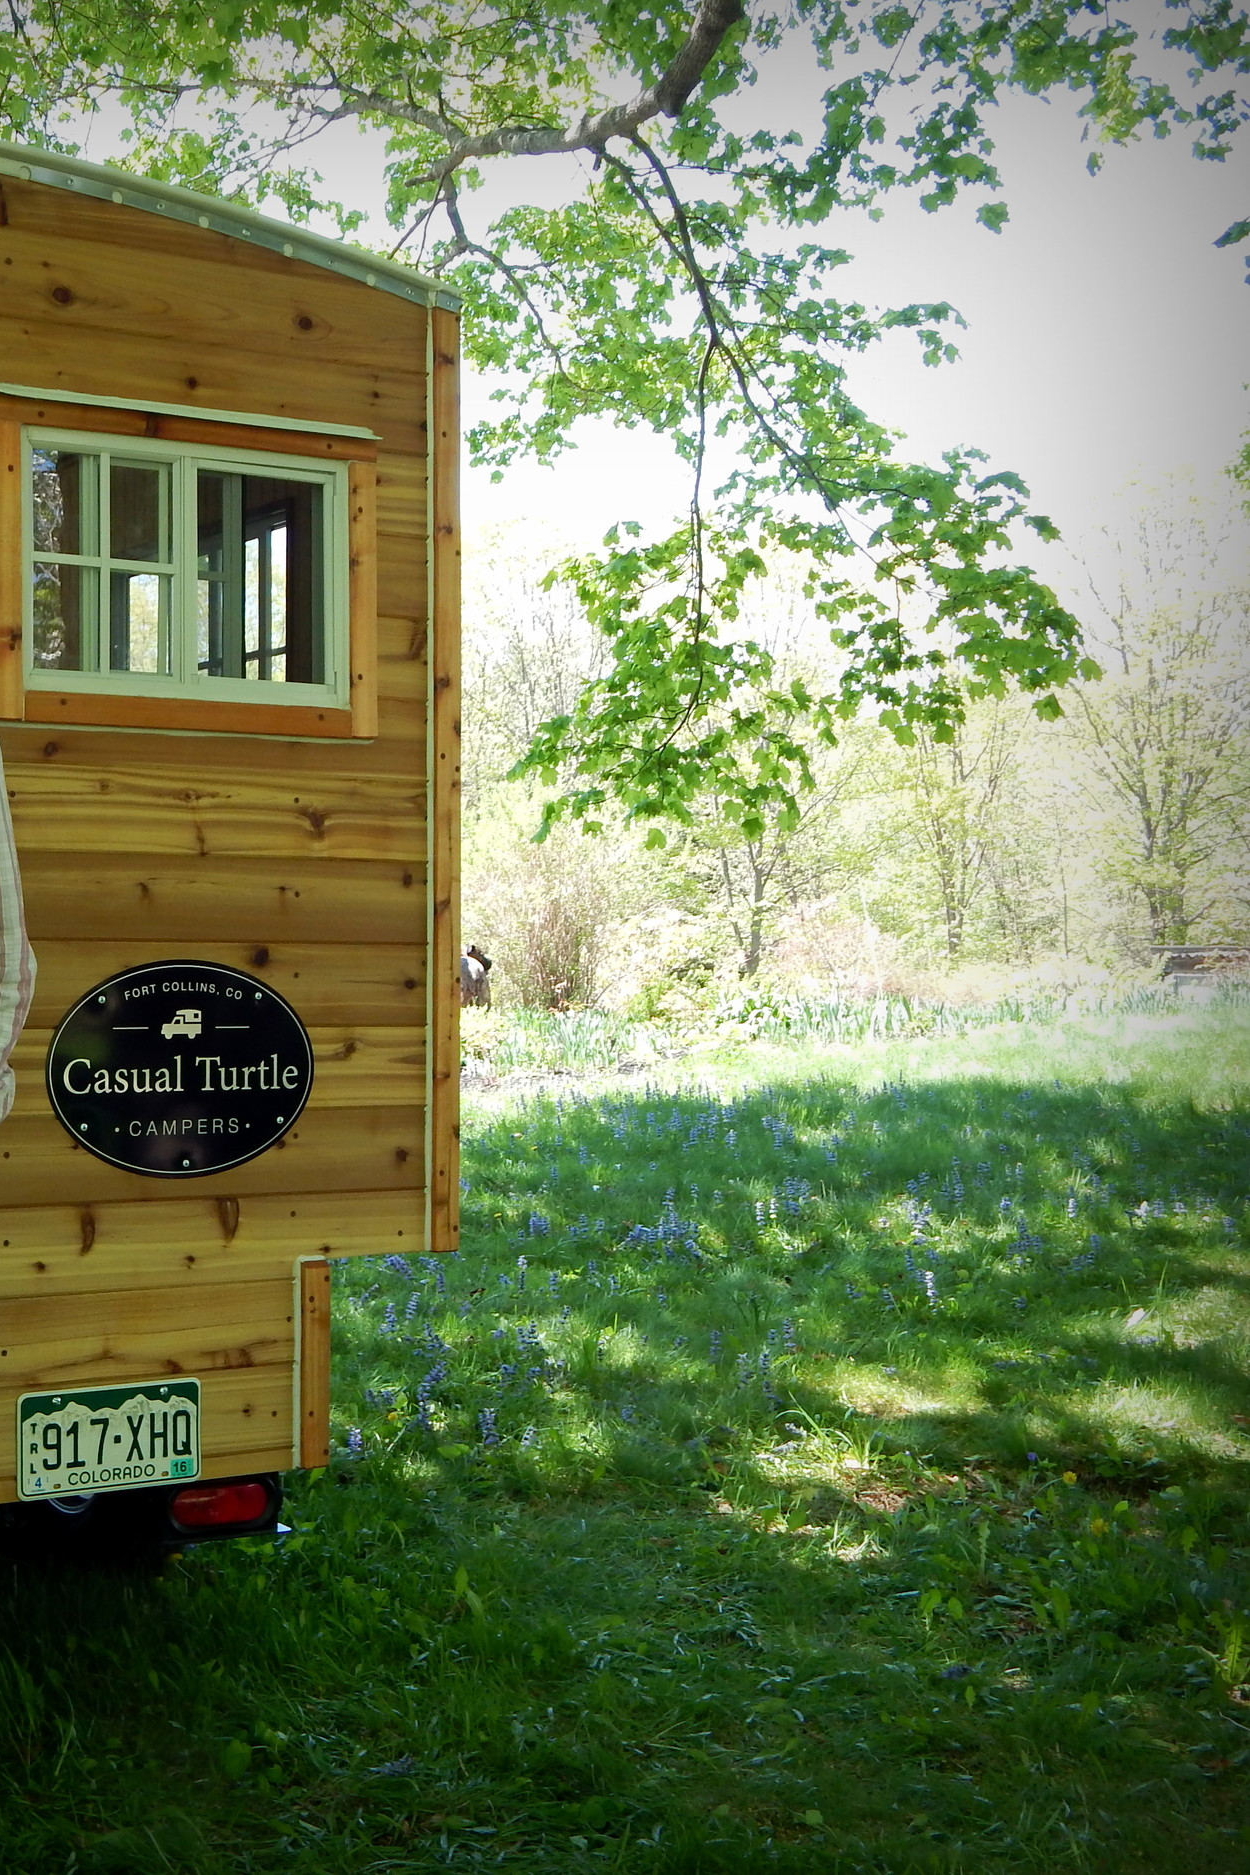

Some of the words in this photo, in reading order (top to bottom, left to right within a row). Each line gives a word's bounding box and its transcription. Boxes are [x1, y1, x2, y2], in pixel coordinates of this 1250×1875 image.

[124, 984, 156, 1001] FORT
[162, 981, 220, 996] COLLINS,
[225, 987, 243, 1000] CO
[63, 1055, 184, 1095] Casual
[195, 1054, 298, 1091] Turtle
[129, 1118, 239, 1136] CAMPERS
[68, 1464, 156, 1485] COLORADO
[173, 1461, 187, 1473] 16
[34, 1476, 42, 1488] 4
